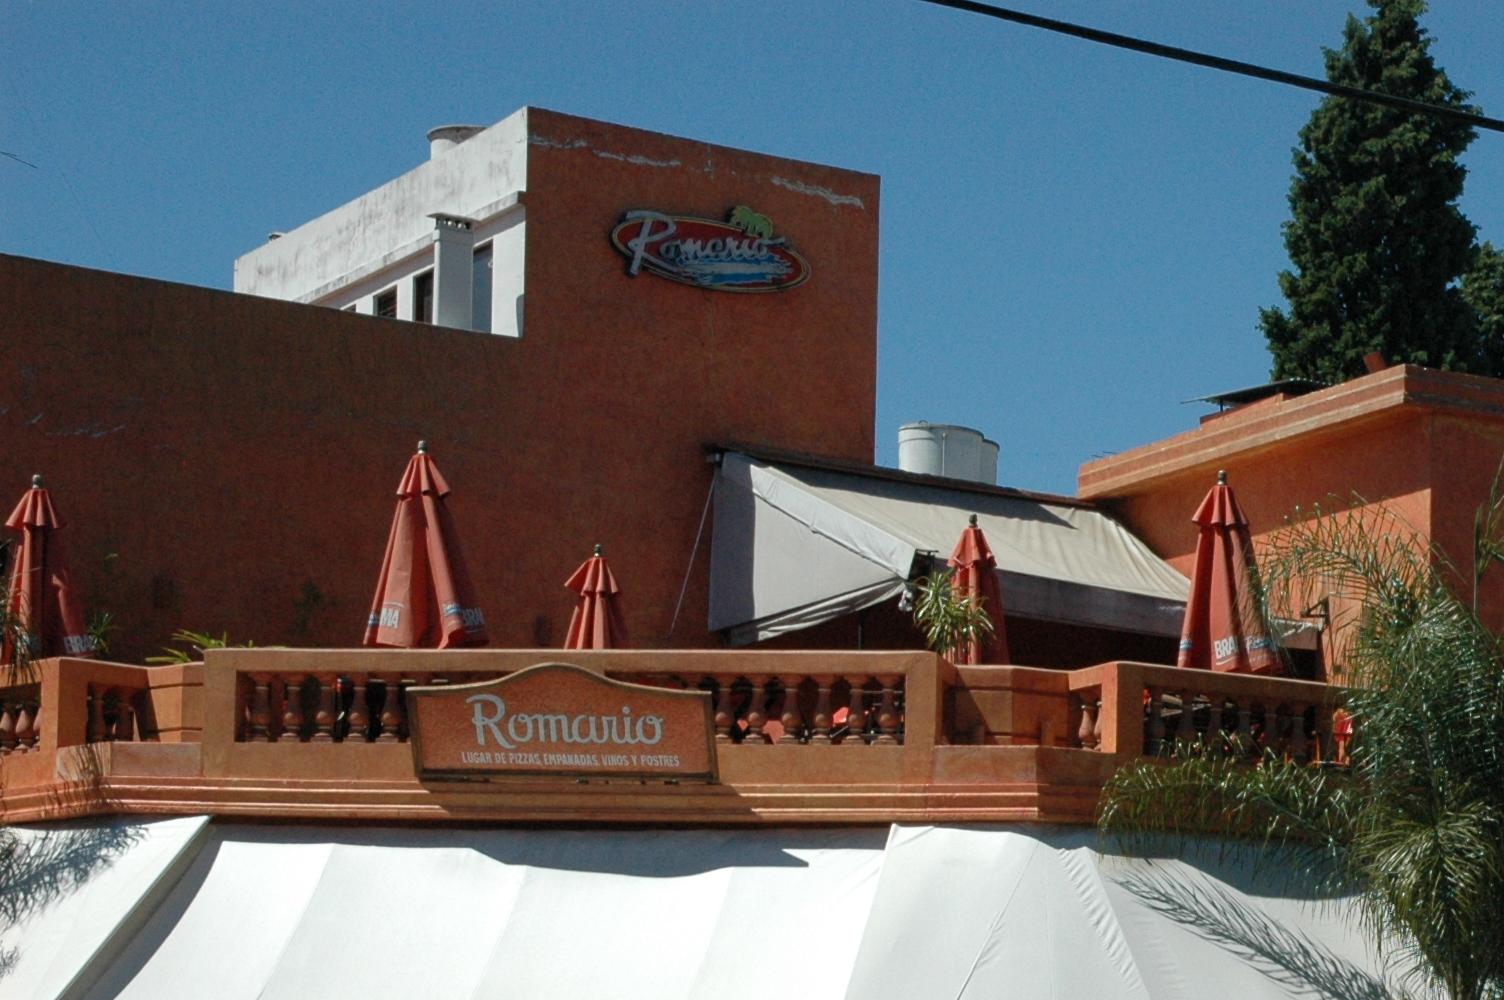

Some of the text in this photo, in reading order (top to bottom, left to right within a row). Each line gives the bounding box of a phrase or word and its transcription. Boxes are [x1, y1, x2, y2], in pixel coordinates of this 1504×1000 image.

[466, 694, 664, 749] Romario
[462, 751, 493, 764] LUGAR
[495, 752, 507, 764] DE
[602, 755, 629, 767] VINOS
[631, 755, 638, 767] Y
[640, 756, 680, 768] POSTRES
